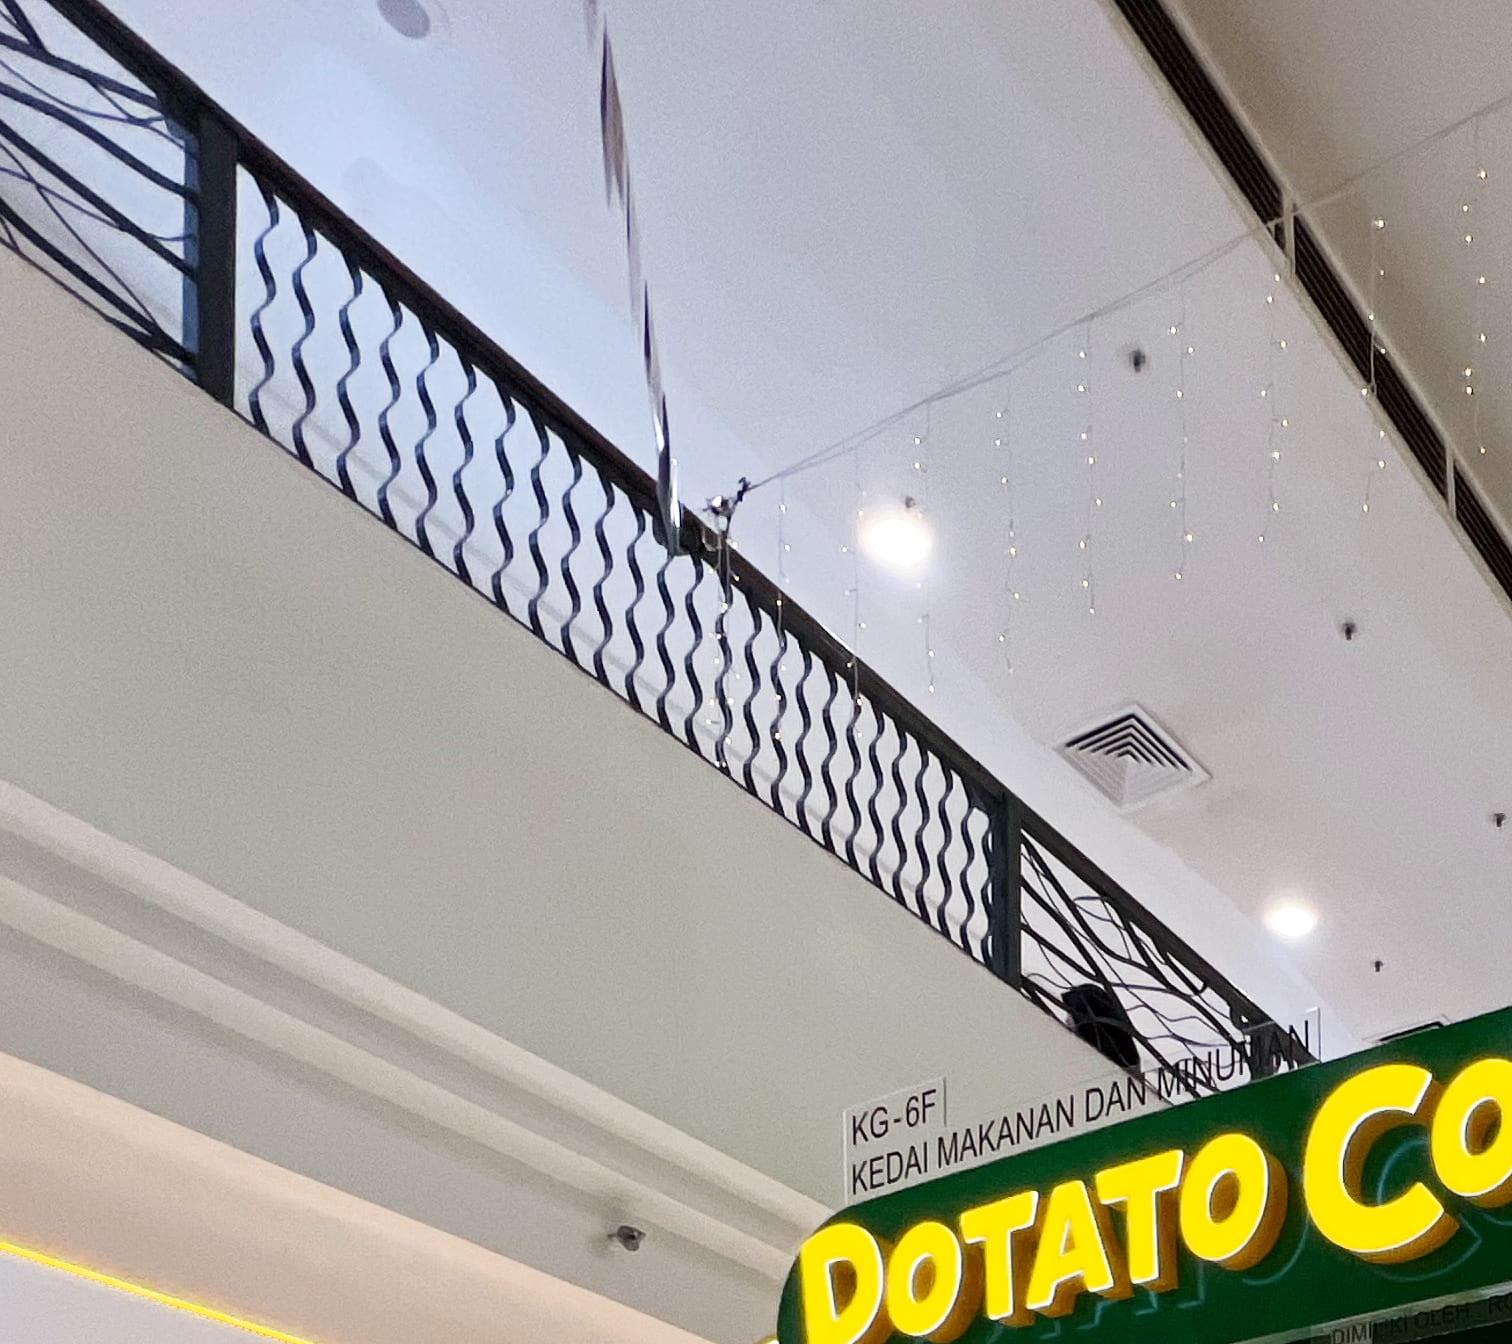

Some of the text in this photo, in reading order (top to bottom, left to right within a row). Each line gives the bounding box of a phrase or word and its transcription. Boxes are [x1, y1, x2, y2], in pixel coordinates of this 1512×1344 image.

[852, 1020, 1310, 1195] KEDAI MAKANAN DAN MINUMAN
[852, 1089, 937, 1146] KG-6F
